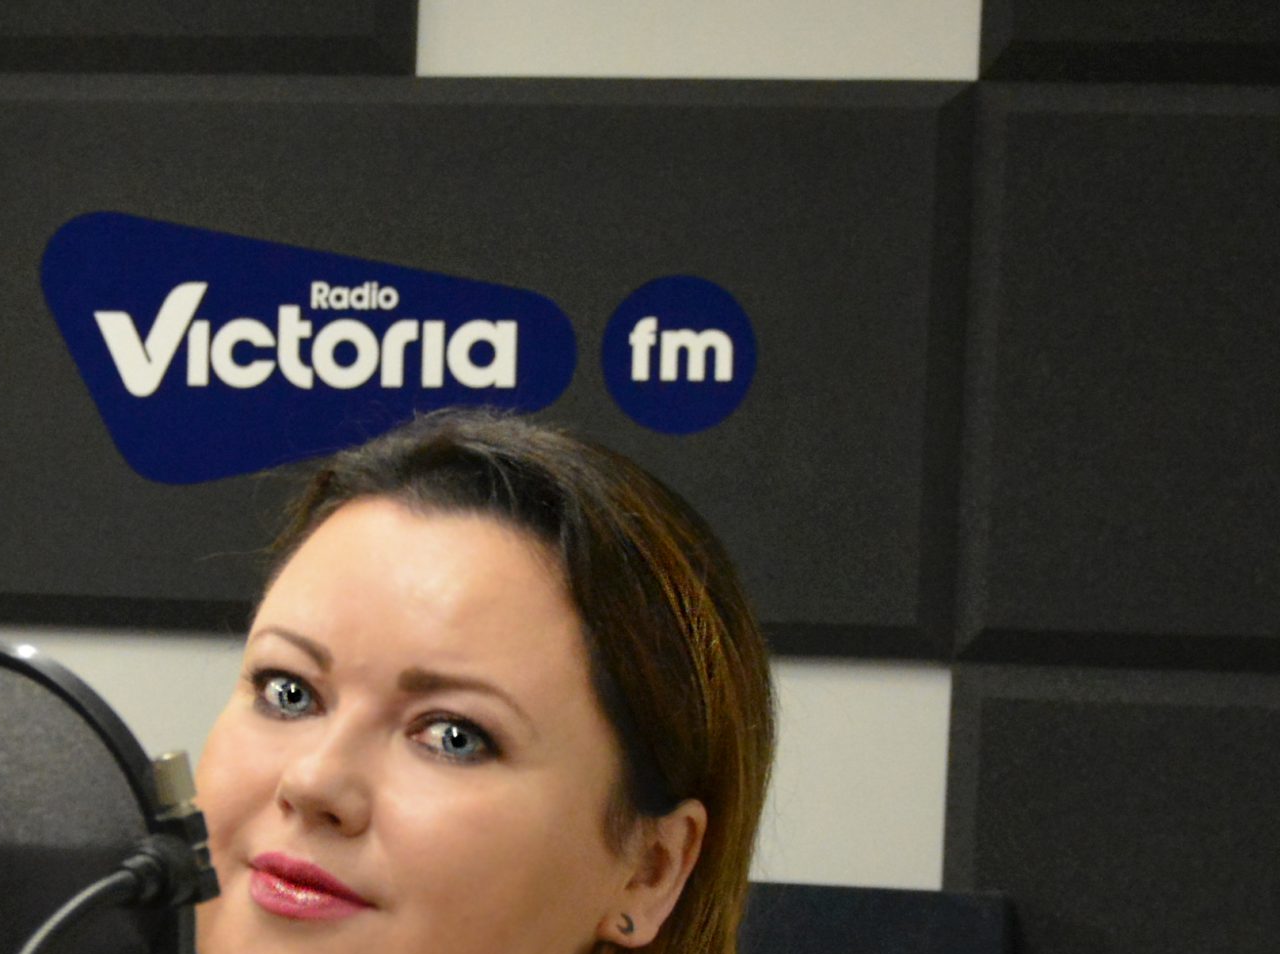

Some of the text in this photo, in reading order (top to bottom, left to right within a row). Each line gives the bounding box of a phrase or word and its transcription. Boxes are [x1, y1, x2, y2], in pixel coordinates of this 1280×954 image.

[310, 281, 399, 311] Radio
[94, 282, 734, 398] Victoria fm
